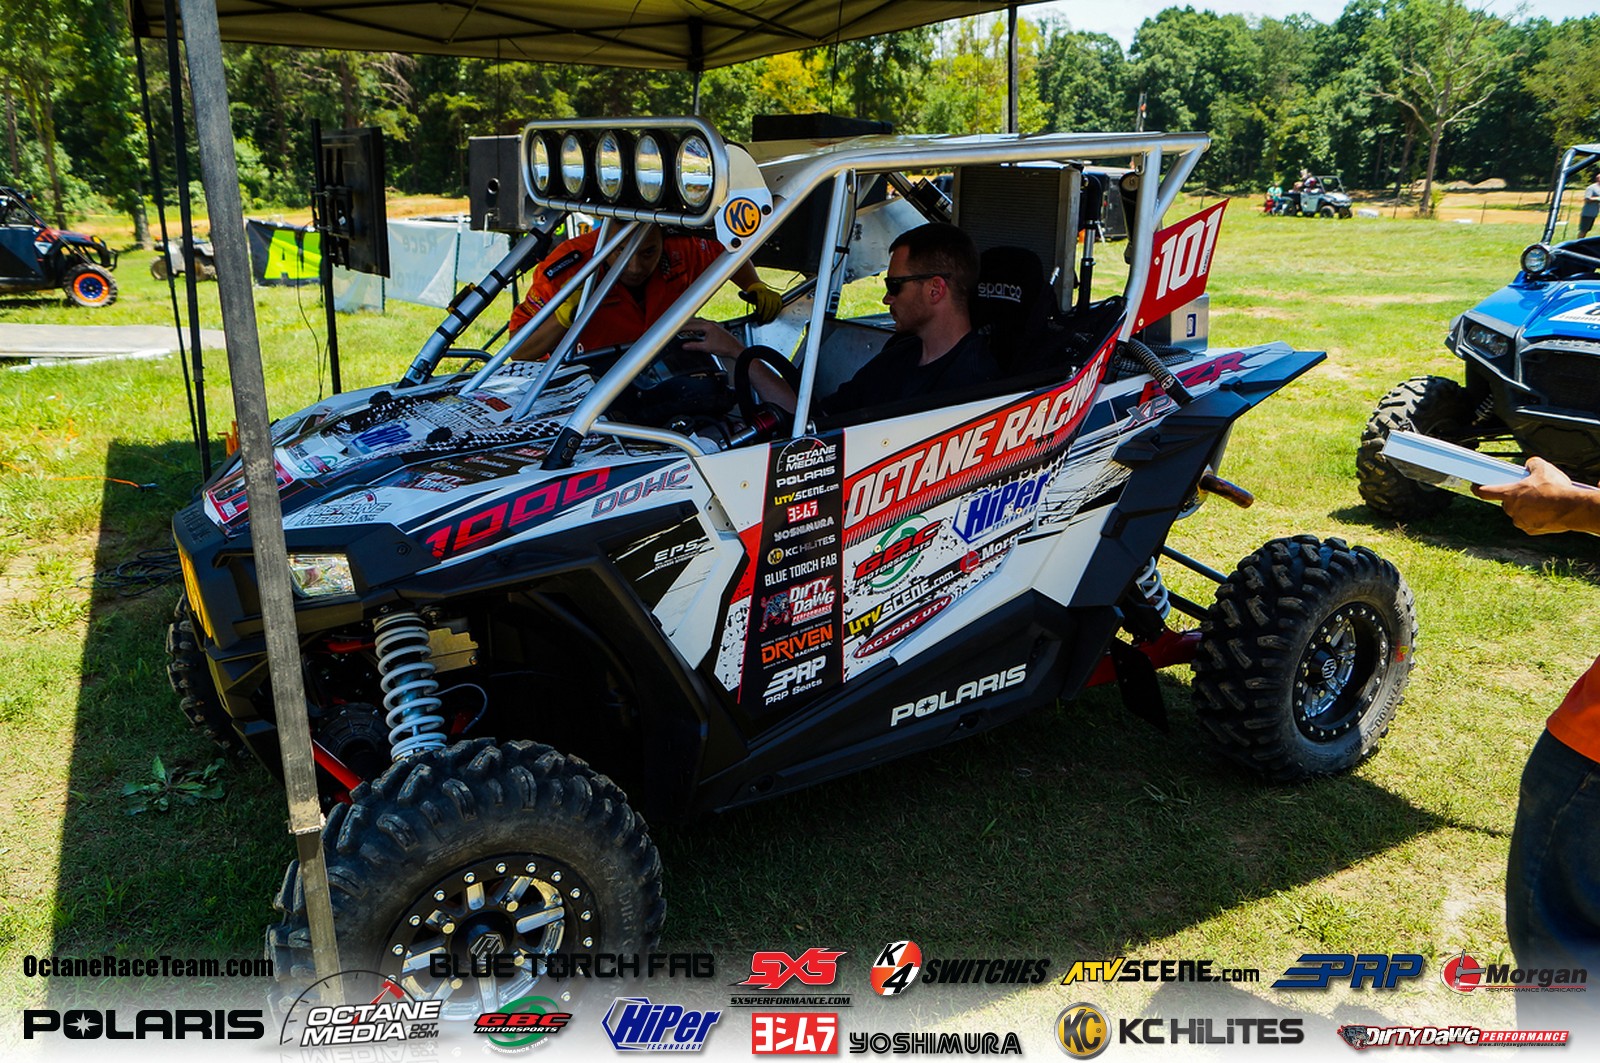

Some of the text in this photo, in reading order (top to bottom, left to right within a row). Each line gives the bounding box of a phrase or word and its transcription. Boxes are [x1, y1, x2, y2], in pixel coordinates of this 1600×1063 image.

[729, 201, 756, 233] KC
[1156, 206, 1224, 300] 101
[978, 282, 1022, 302] sparco
[786, 444, 837, 463] OCTANE
[844, 348, 1106, 529] OCTANE RACING
[776, 465, 836, 488] POLARIS
[785, 455, 825, 472] MEDIA
[591, 464, 692, 519] DOHC
[774, 483, 840, 506] UTVSCENE.com
[964, 471, 1051, 542] HiPer
[426, 466, 611, 558] 1000
[774, 516, 835, 542] YOSHIMURA
[654, 539, 701, 563] EPS
[785, 546, 799, 558] KC
[854, 520, 941, 580] GBC
[855, 539, 932, 587] MOTORSPORTS
[764, 553, 838, 587] BLUE TORCH FAB
[849, 571, 955, 635] UTVSCENE.com
[761, 624, 834, 664] DRIVEN
[857, 598, 949, 657] FACTORY UTV
[794, 645, 820, 658] RACING
[762, 655, 827, 697] PRP
[765, 691, 789, 706] PRP
[890, 663, 1028, 727] POLARIS
